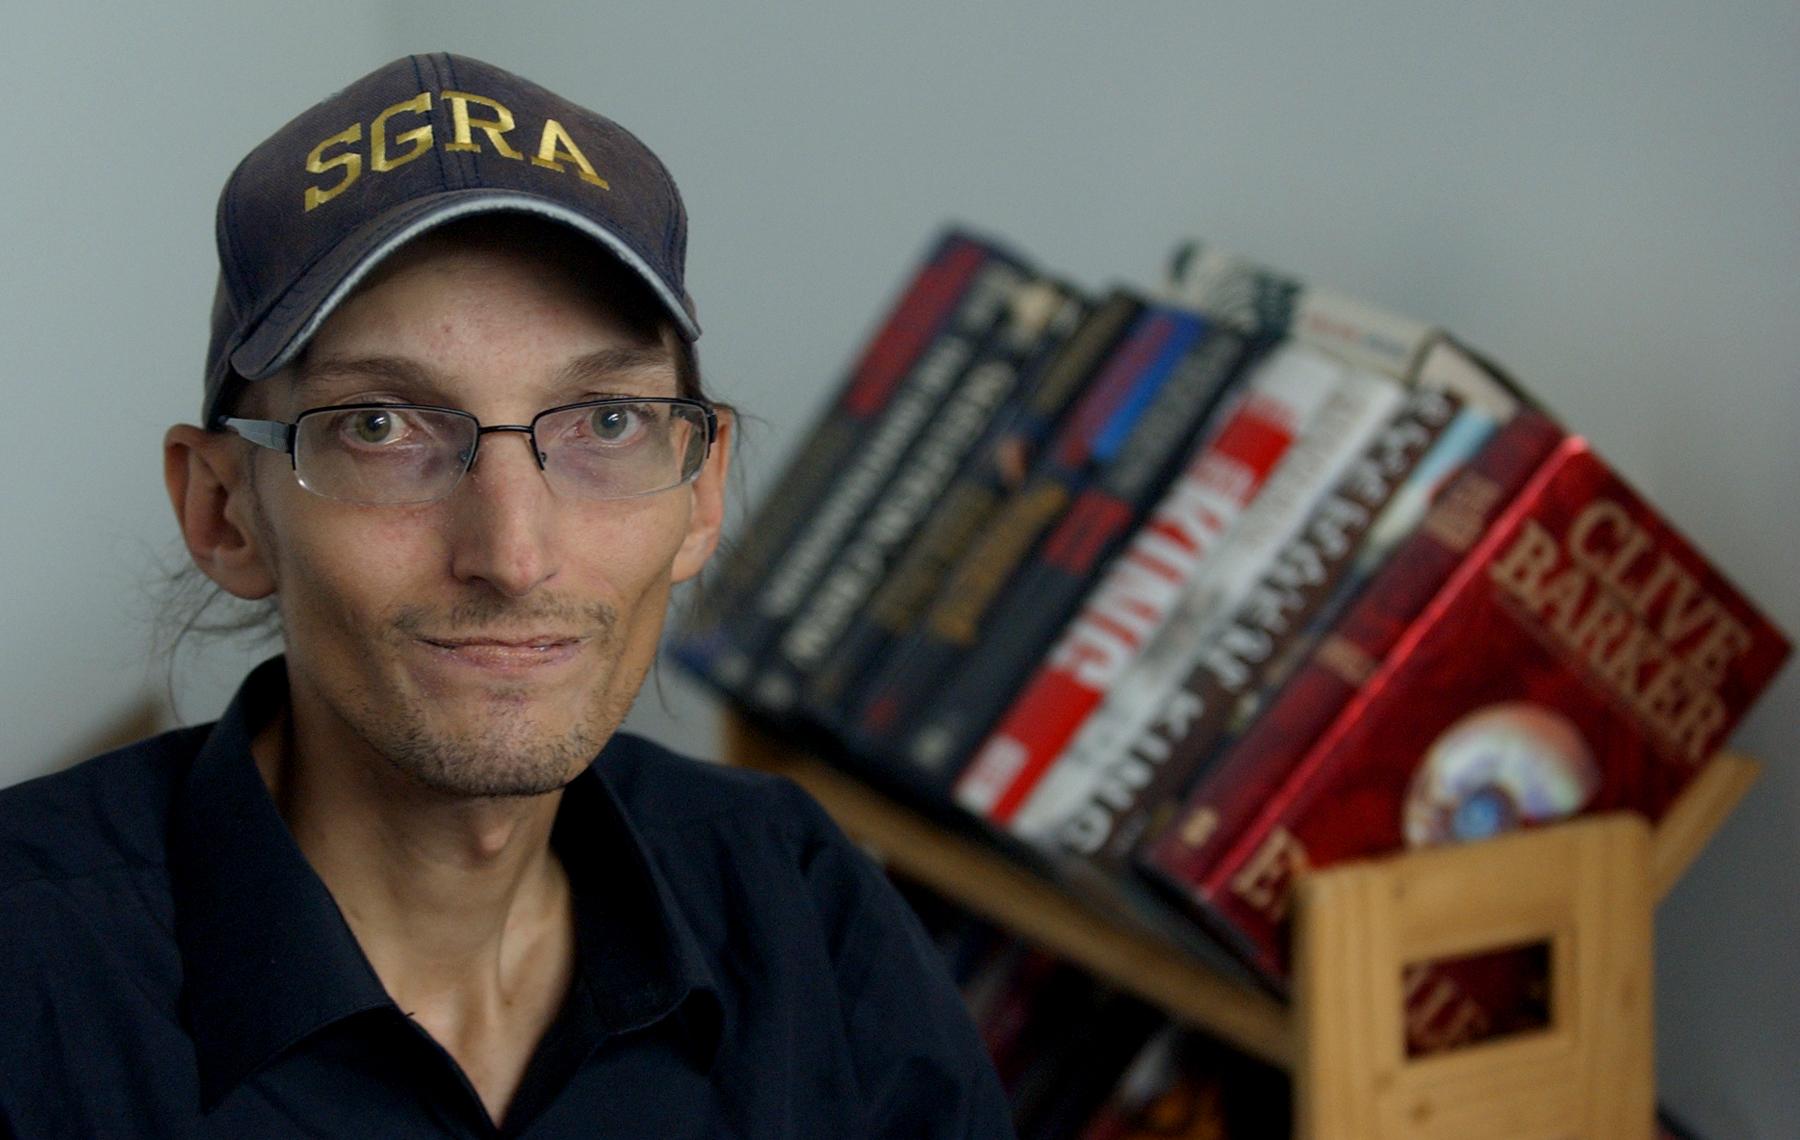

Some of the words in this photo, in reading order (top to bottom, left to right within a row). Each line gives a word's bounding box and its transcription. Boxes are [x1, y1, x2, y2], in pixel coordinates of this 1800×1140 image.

[305, 89, 610, 213] SGRA
[1052, 484, 1240, 692] KING
[1490, 519, 1727, 763] BARKER
[1569, 499, 1756, 688] CLIVE
